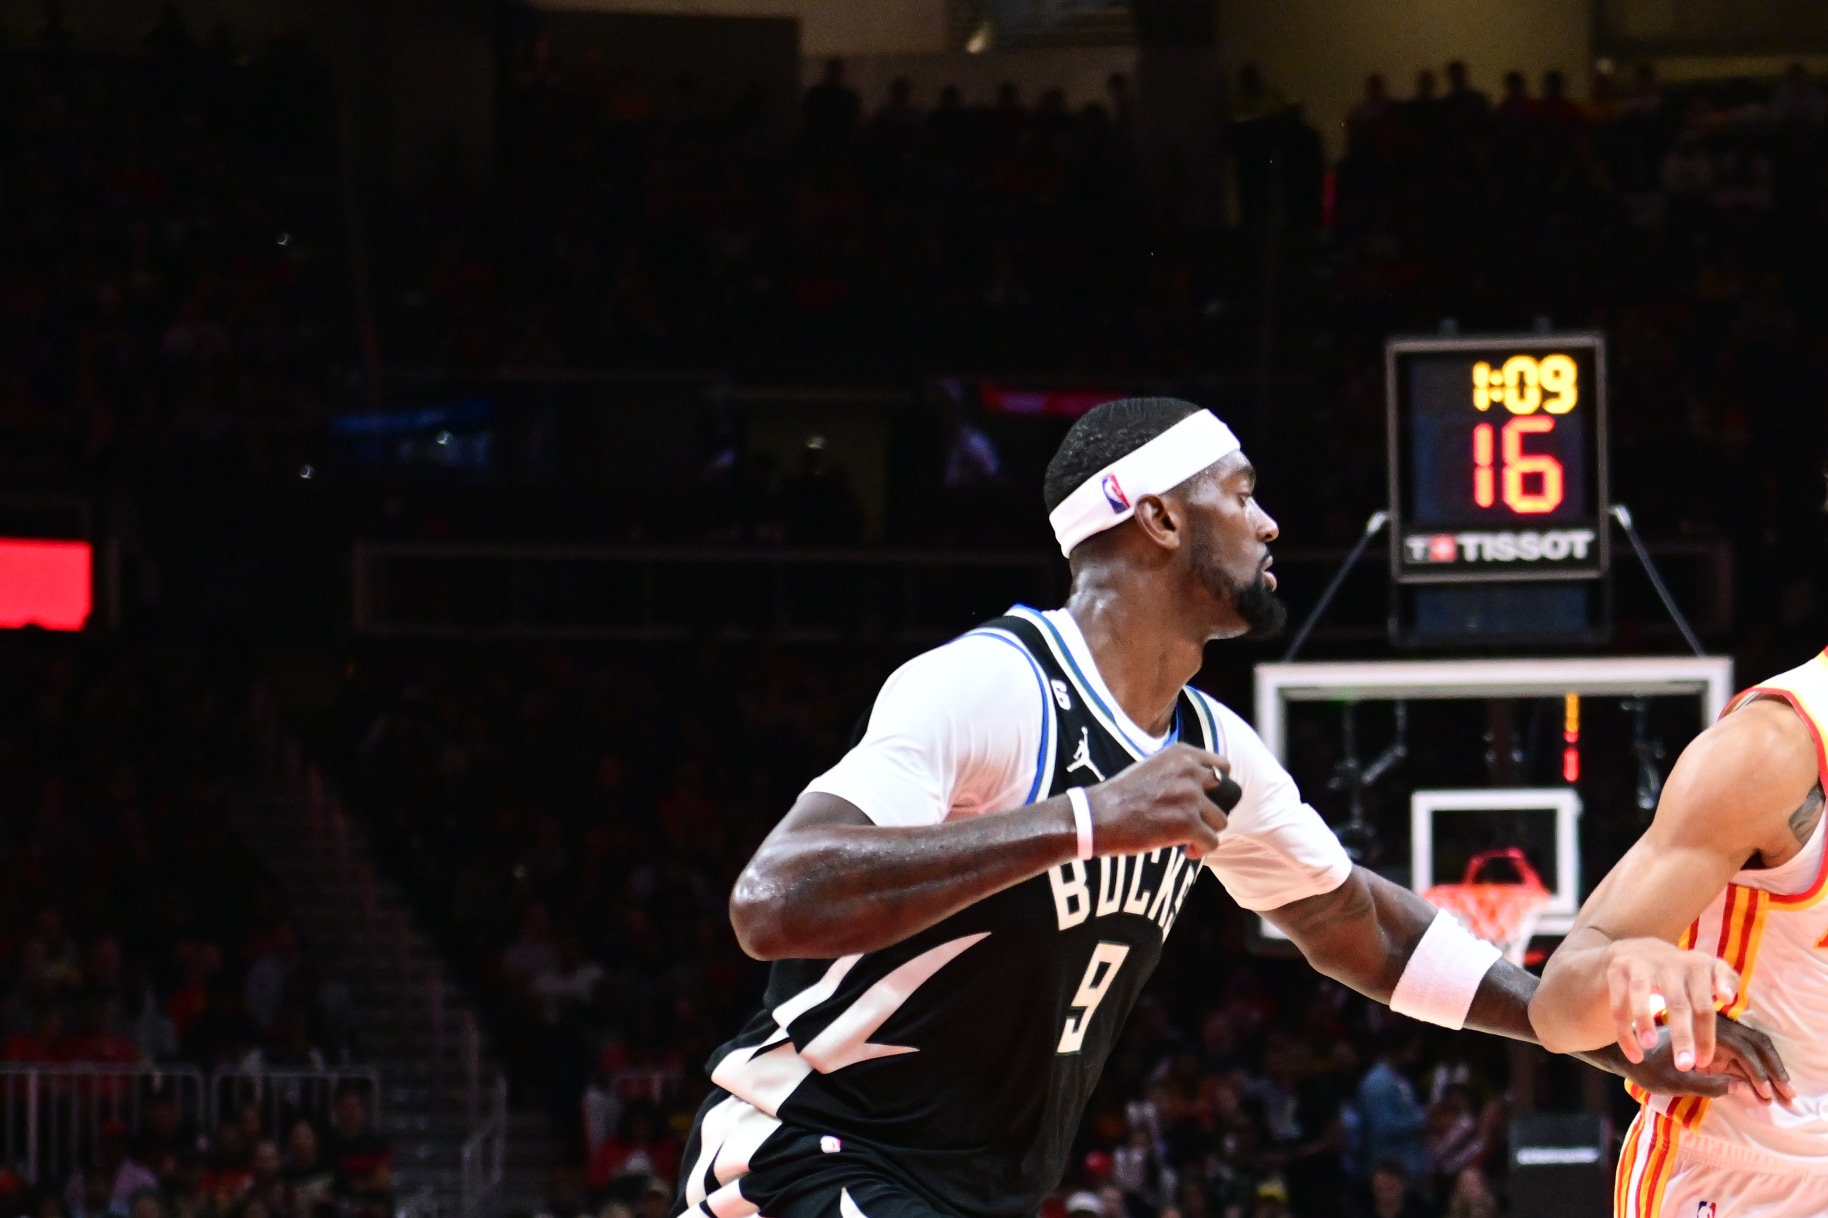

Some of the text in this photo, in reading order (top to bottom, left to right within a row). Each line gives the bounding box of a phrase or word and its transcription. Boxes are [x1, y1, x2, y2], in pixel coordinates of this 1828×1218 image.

[1472, 354, 1577, 415] 1:09
[1472, 414, 1564, 514] 16
[1458, 528, 1594, 562] TISSOT
[1055, 941, 1131, 1055] 9
